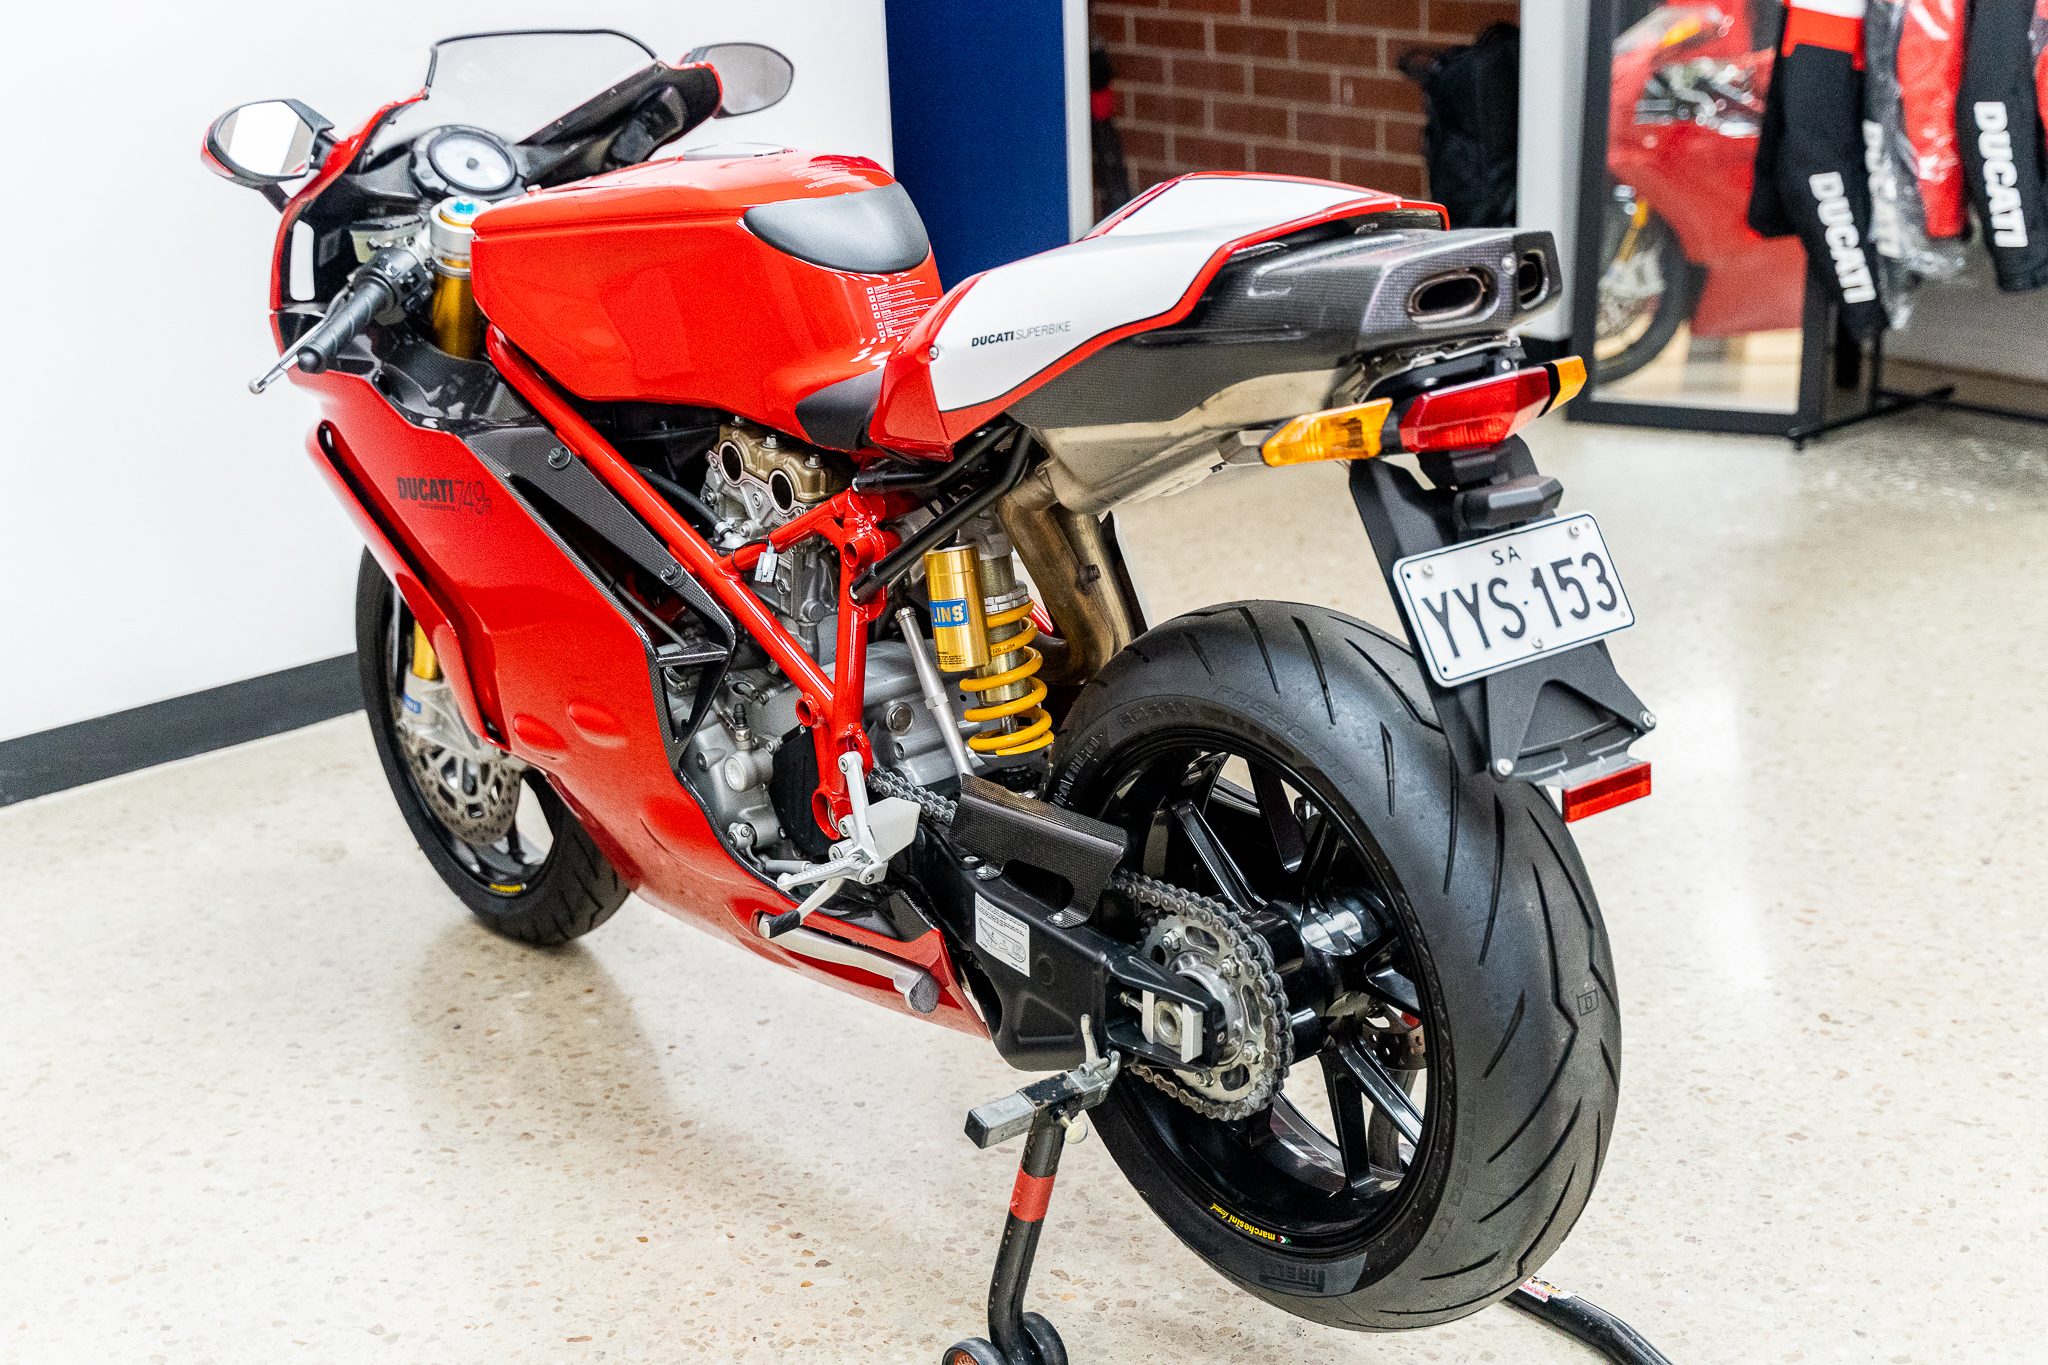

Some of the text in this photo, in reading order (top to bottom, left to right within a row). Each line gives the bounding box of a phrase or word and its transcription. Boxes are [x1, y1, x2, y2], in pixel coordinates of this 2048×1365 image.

[1974, 101, 2028, 247] DUCATI
[1809, 171, 1877, 303] DUCATI
[971, 320, 1072, 347] DUCATI SUPERBIKE
[396, 476, 454, 502] DUCATI
[1491, 546, 1522, 566] SA
[1228, 1214, 1276, 1241] marchesini
